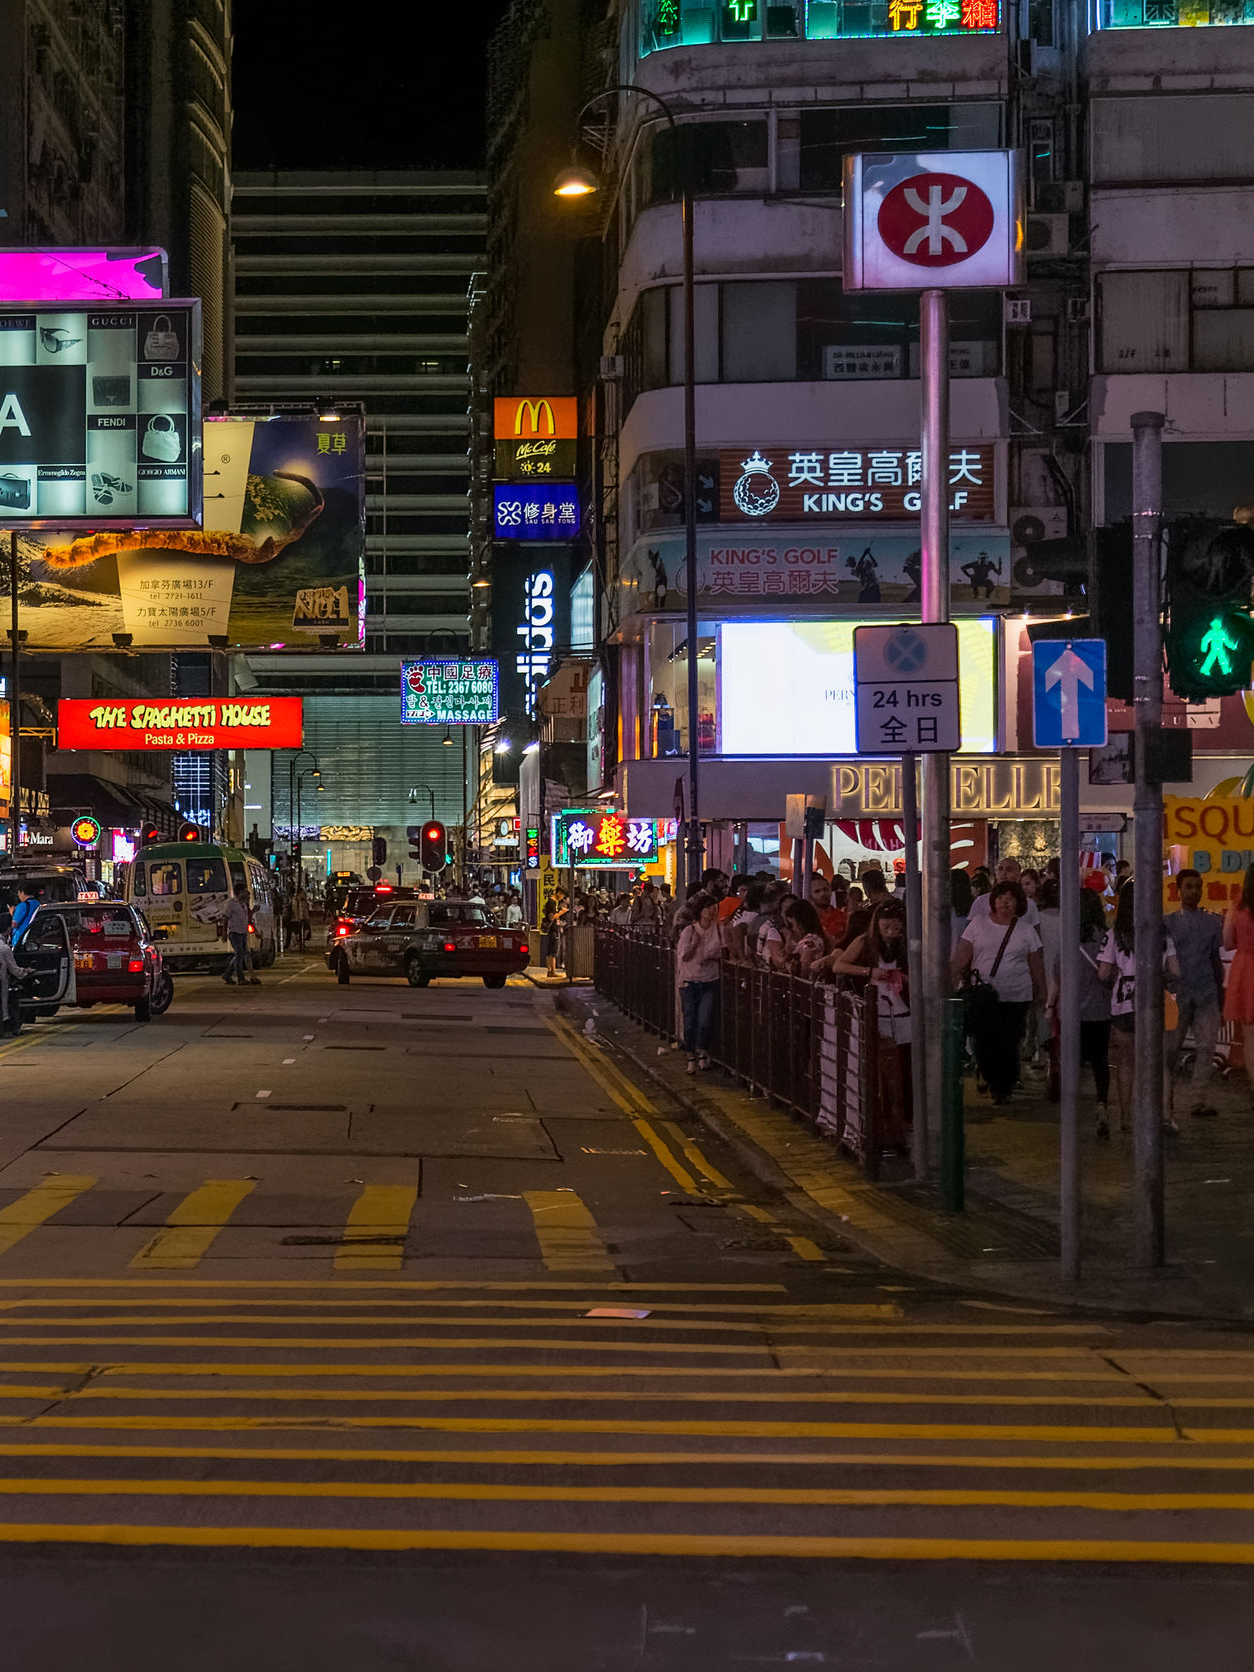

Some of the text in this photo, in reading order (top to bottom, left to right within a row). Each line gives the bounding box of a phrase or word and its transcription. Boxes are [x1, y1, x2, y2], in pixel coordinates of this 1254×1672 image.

[92, 317, 133, 327] GUCCI
[151, 366, 173, 377] D&G
[97, 418, 126, 427] FENDI
[316, 433, 347, 456] 夏草
[38, 469, 69, 478] Ermenegildo
[164, 468, 186, 476] ARMANI
[537, 462, 552, 473] 24
[803, 492, 968, 512] KING'S GF
[524, 502, 576, 519] 修身堂
[711, 549, 838, 565] KING'S GOLF
[711, 570, 839, 595] 英皇高爾夫
[427, 665, 493, 681] 中國足療
[427, 681, 493, 694] TEL: 2367 6080
[872, 689, 943, 708] 24 hrs
[90, 705, 271, 729] THE SPAGHETTI HOUSE
[437, 709, 494, 720] MASSAGE
[879, 716, 939, 744] 全日
[145, 734, 214, 745] Pasta & Pizza
[833, 765, 1061, 812] PEELLE
